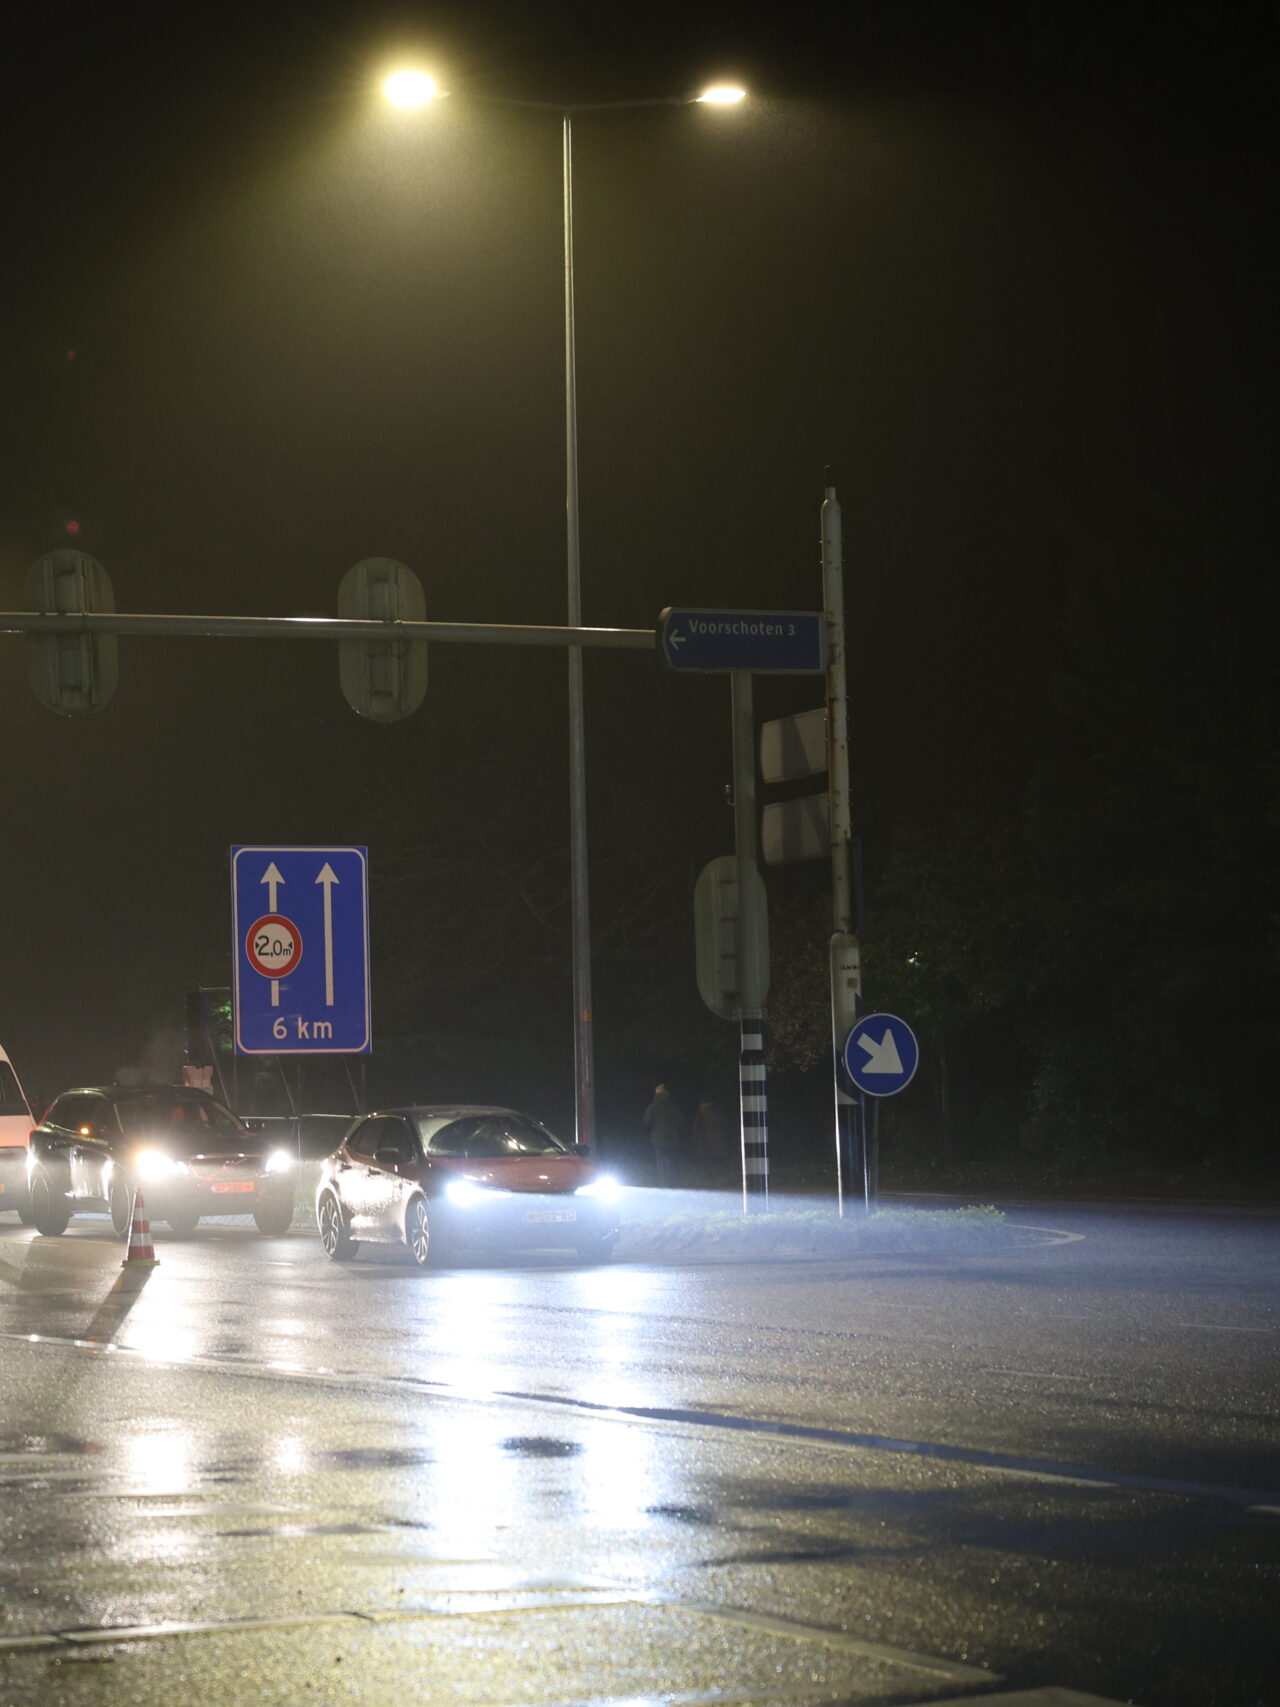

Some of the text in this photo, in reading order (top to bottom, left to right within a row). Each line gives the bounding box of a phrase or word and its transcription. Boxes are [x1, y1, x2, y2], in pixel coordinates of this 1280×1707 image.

[689, 619, 796, 636] Voorschoten 3
[273, 1016, 333, 1039] 6 km
